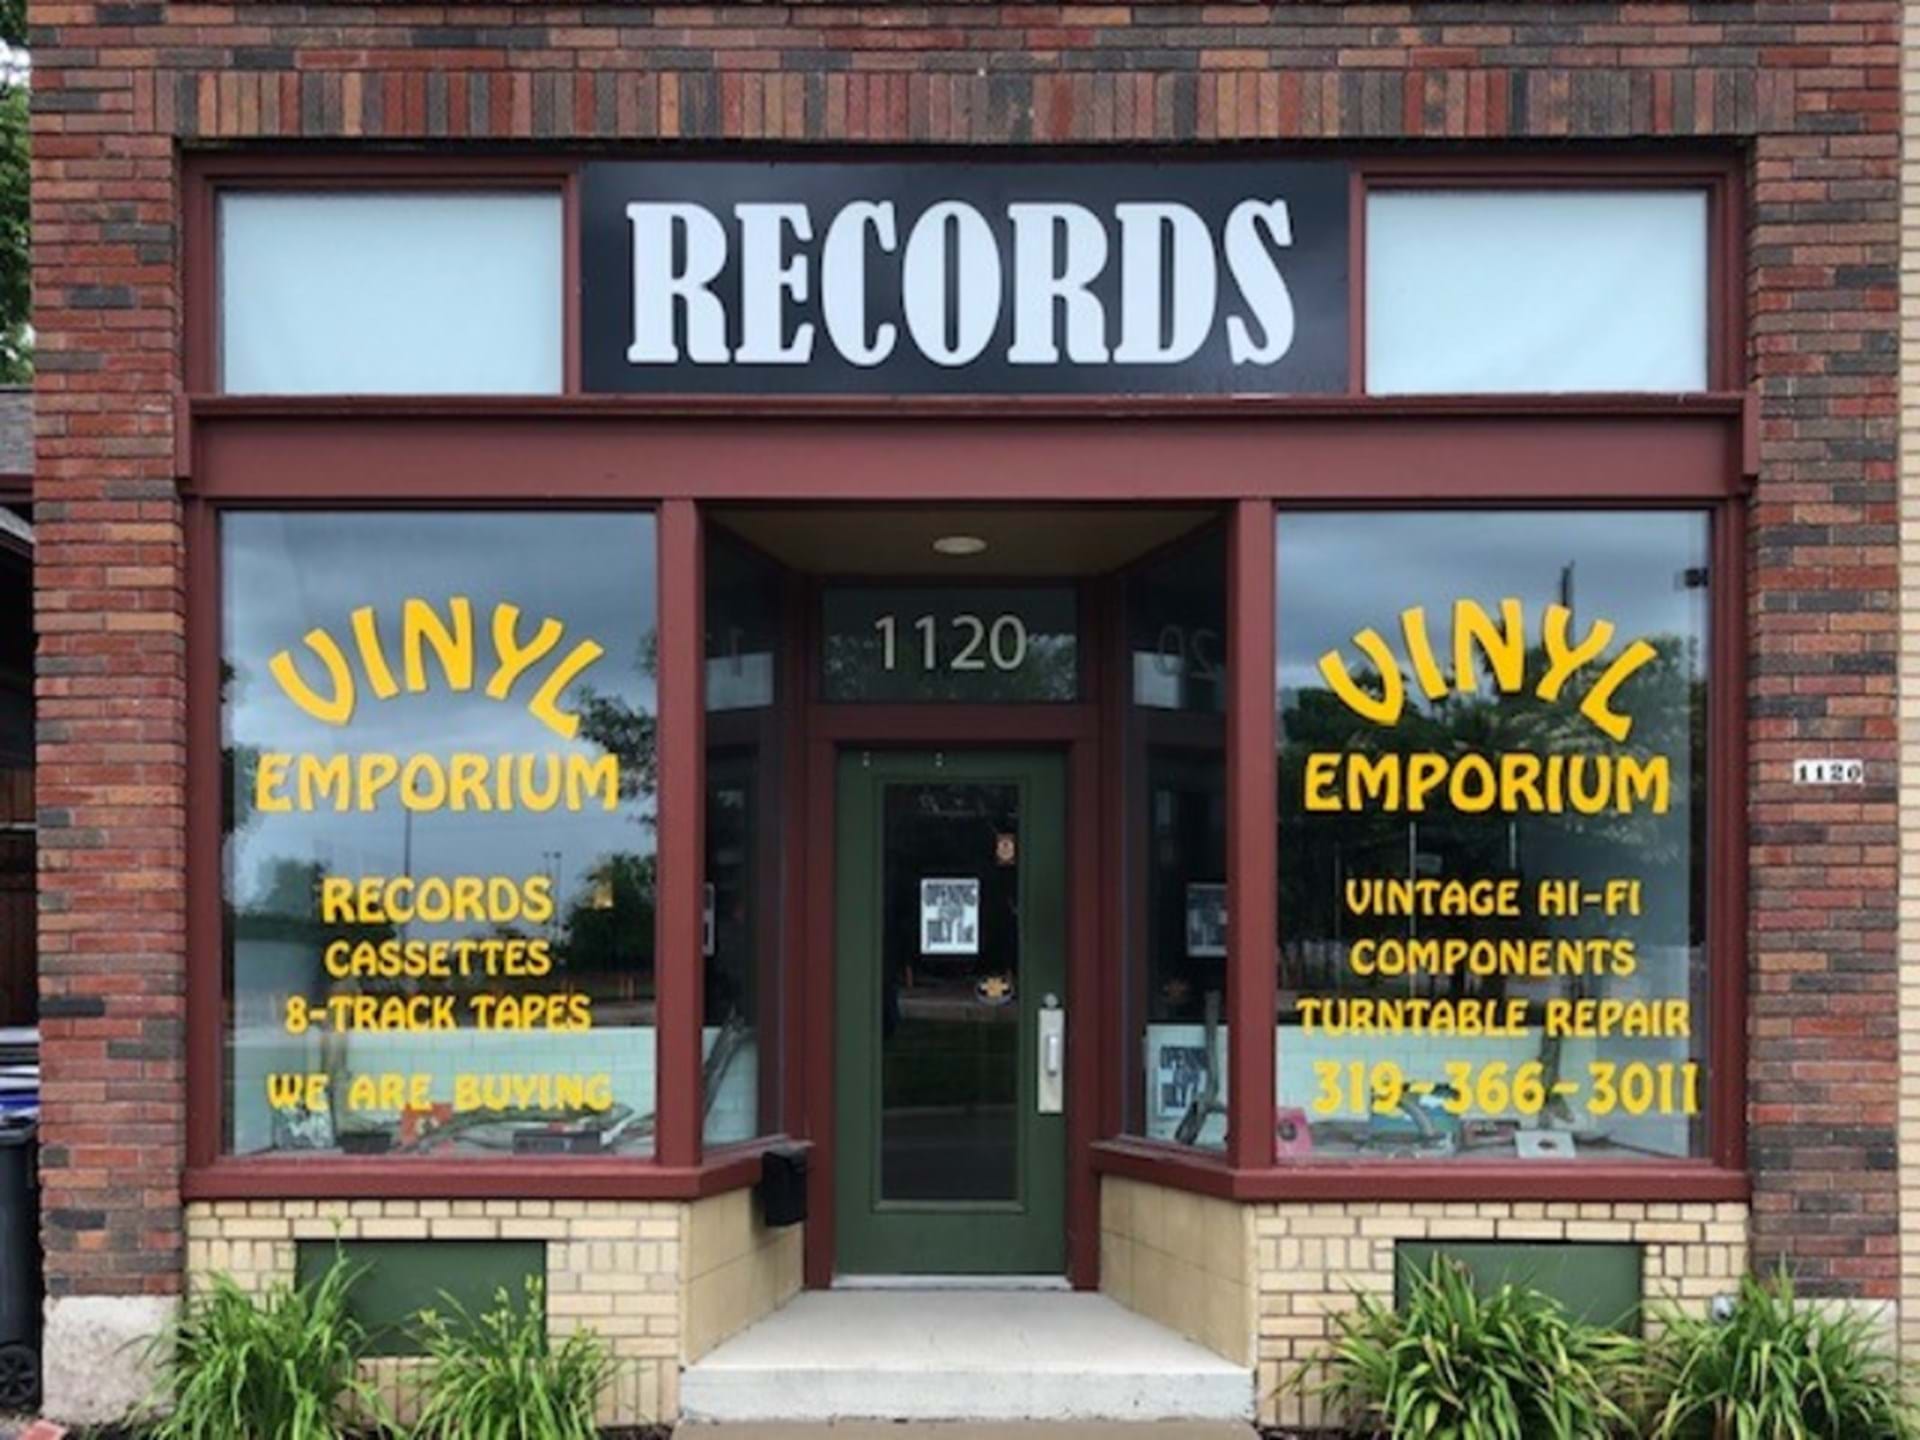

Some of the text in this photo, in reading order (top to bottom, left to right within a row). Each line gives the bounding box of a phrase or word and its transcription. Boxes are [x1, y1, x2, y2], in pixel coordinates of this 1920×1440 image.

[626, 199, 1295, 366] RECORDS
[873, 615, 1028, 671] 1120
[269, 597, 603, 739] VINYL
[1318, 598, 1657, 742] VINYL
[256, 753, 620, 812] EMPORIUM
[1304, 753, 1670, 814] EMPORIUM
[1800, 764, 1861, 780] 1120
[322, 876, 553, 923] RECORDS
[1346, 880, 1641, 915] VINTAGE HI-FI
[325, 940, 552, 976] CASSETTES
[1350, 939, 1637, 976] COMPONENTS
[285, 995, 592, 1034] 8-TRACK TAPES
[1297, 998, 1691, 1038] TURNTABLE REPAIR
[267, 1073, 613, 1112] WE ARE BUYING
[1312, 1061, 1698, 1115] 319-366-3011
